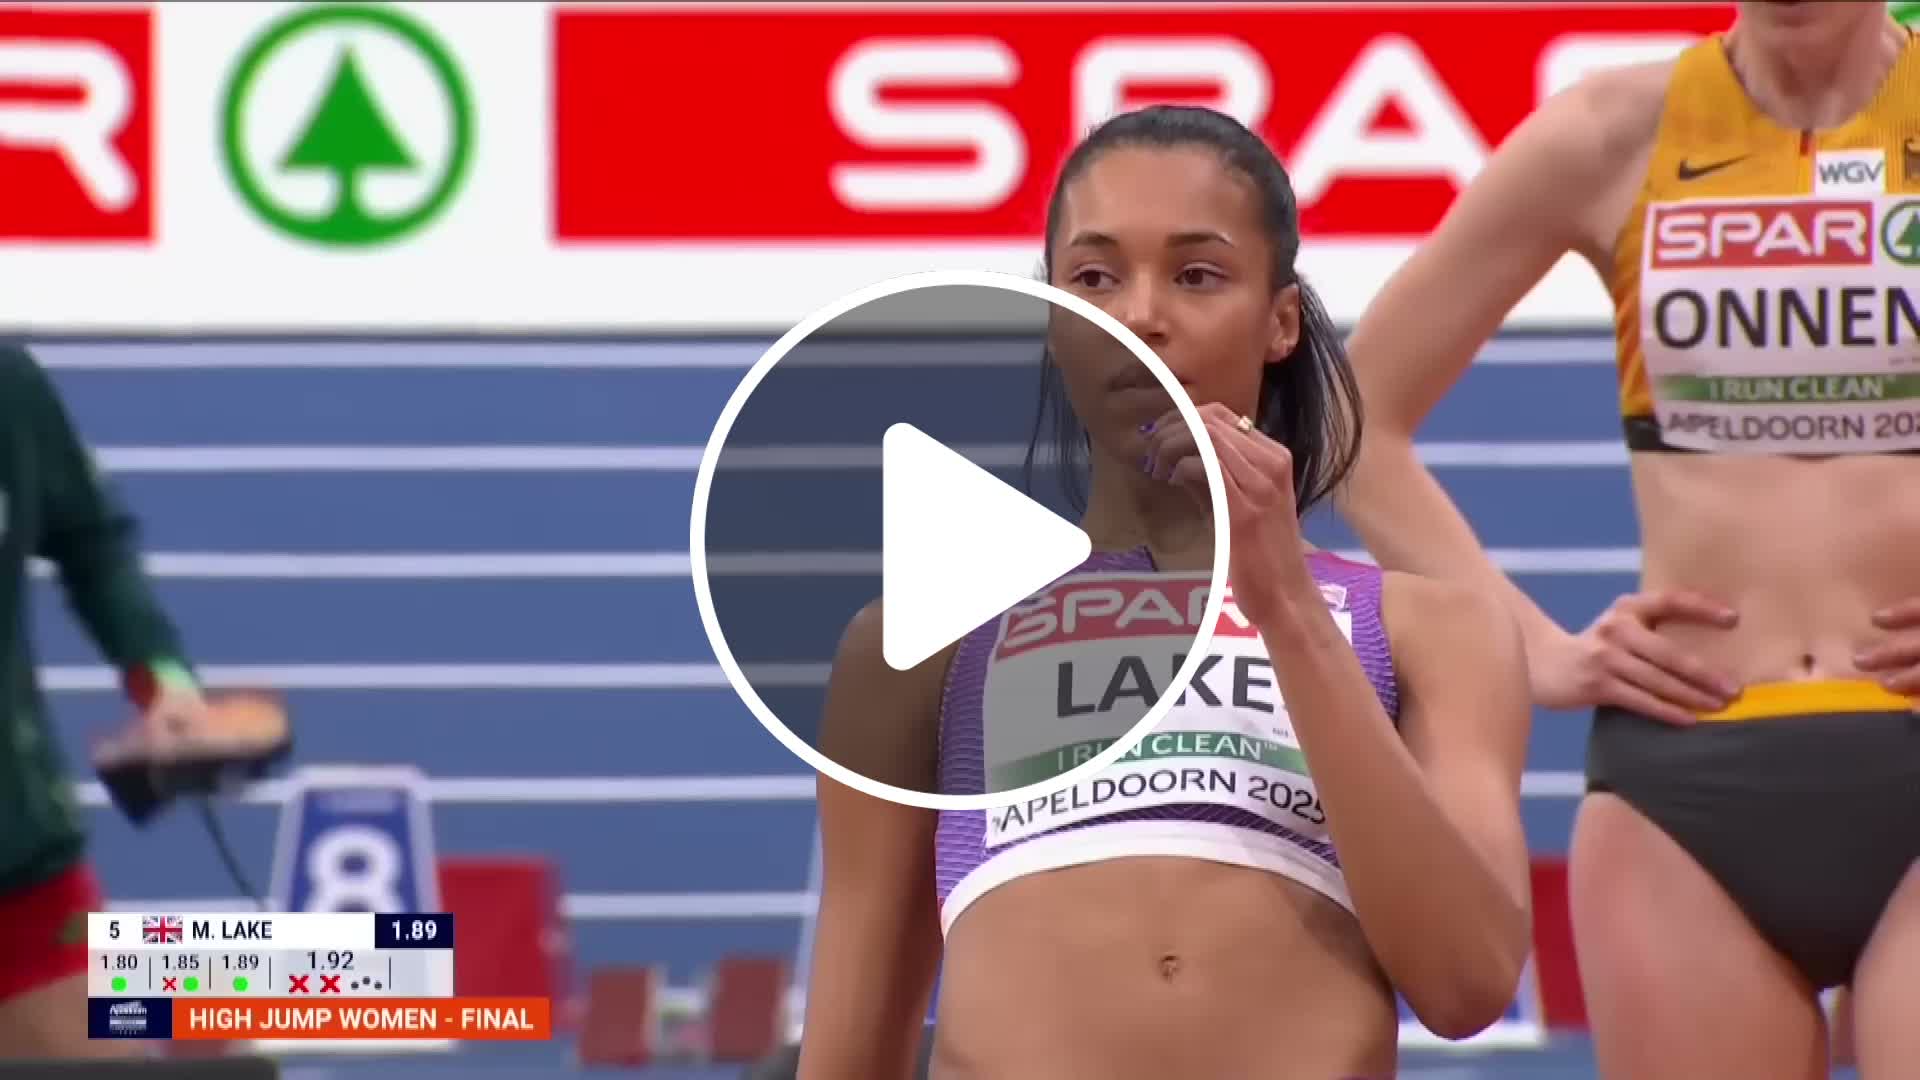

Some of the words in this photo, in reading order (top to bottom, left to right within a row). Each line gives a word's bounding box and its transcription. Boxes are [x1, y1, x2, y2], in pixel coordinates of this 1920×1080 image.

[830, 34, 1690, 210] SPA
[1818, 160, 1884, 183] WGV
[1657, 210, 1867, 261] SPAR
[1723, 377, 1784, 399] RUN
[1057, 653, 1274, 718] LAKE
[1000, 768, 1236, 833] APELDOORN
